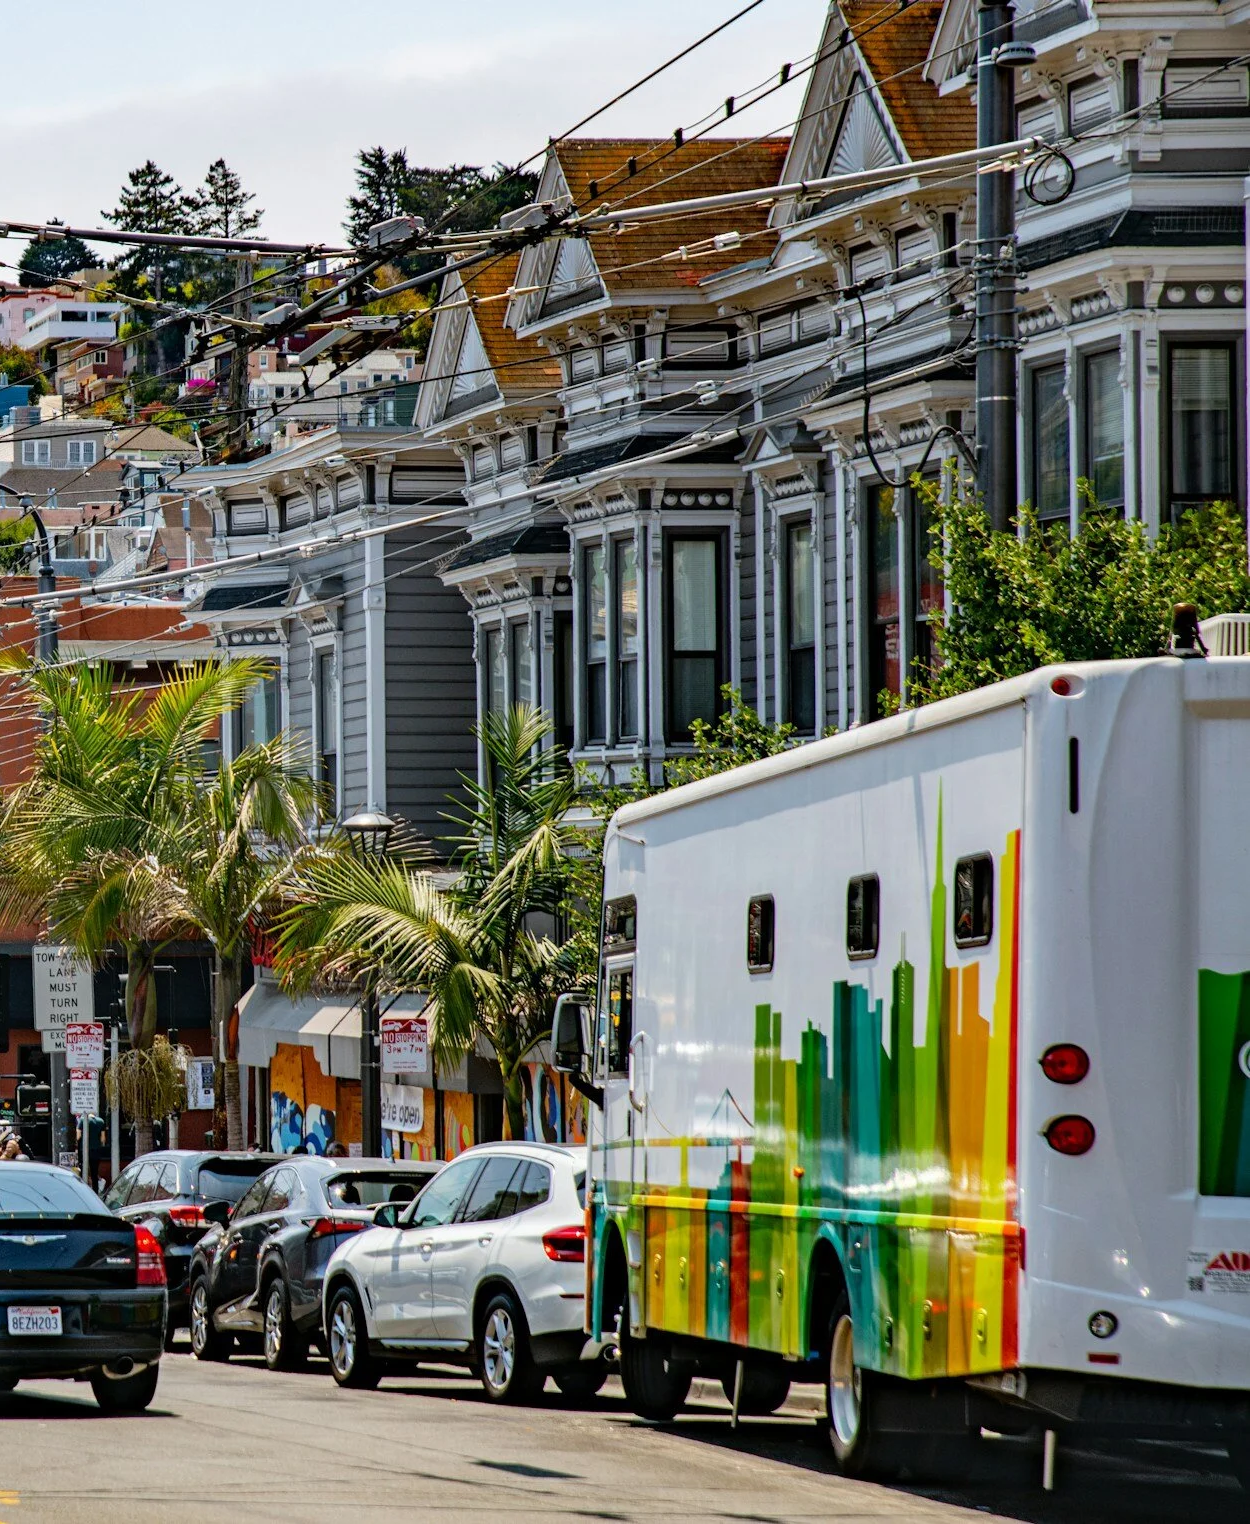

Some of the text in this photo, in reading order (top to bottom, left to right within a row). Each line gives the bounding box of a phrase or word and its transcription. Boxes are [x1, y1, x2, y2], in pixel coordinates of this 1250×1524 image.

[49, 968, 77, 977] LANE
[49, 983, 78, 992] MUST
[50, 998, 78, 1008] TURN
[50, 1013, 79, 1023] RIGHT
[50, 1031, 66, 1040] EXC
[67, 1034, 102, 1043] NO STOPPING
[383, 1032, 426, 1043] NO STOPPING
[398, 1103, 420, 1127] open
[12, 1316, 58, 1330] 8EZH203
